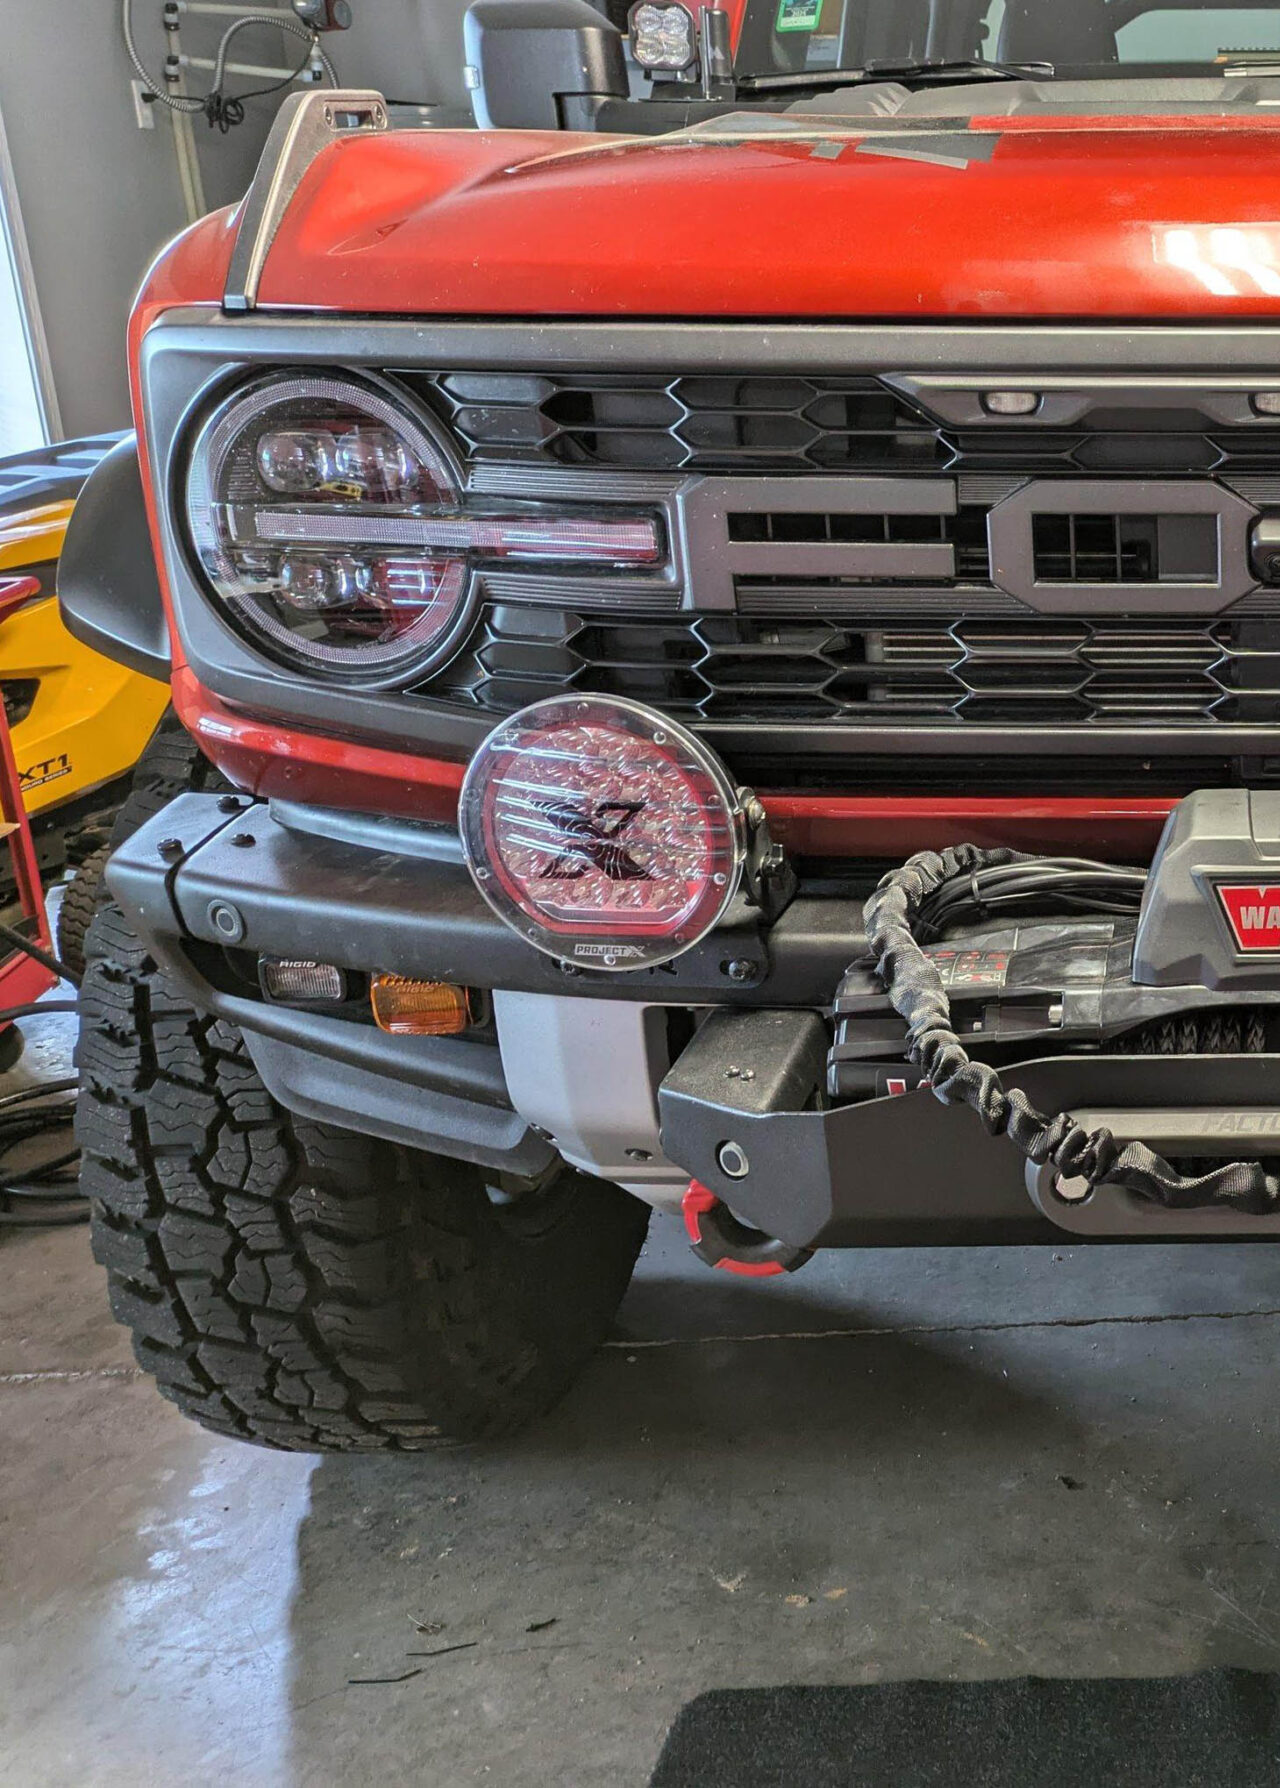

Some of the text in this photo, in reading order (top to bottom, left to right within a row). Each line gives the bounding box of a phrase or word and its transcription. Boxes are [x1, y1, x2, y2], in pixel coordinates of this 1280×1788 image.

[18, 753, 68, 782] XT1
[575, 945, 627, 955] PROJECT
[279, 960, 317, 968] RIGID
